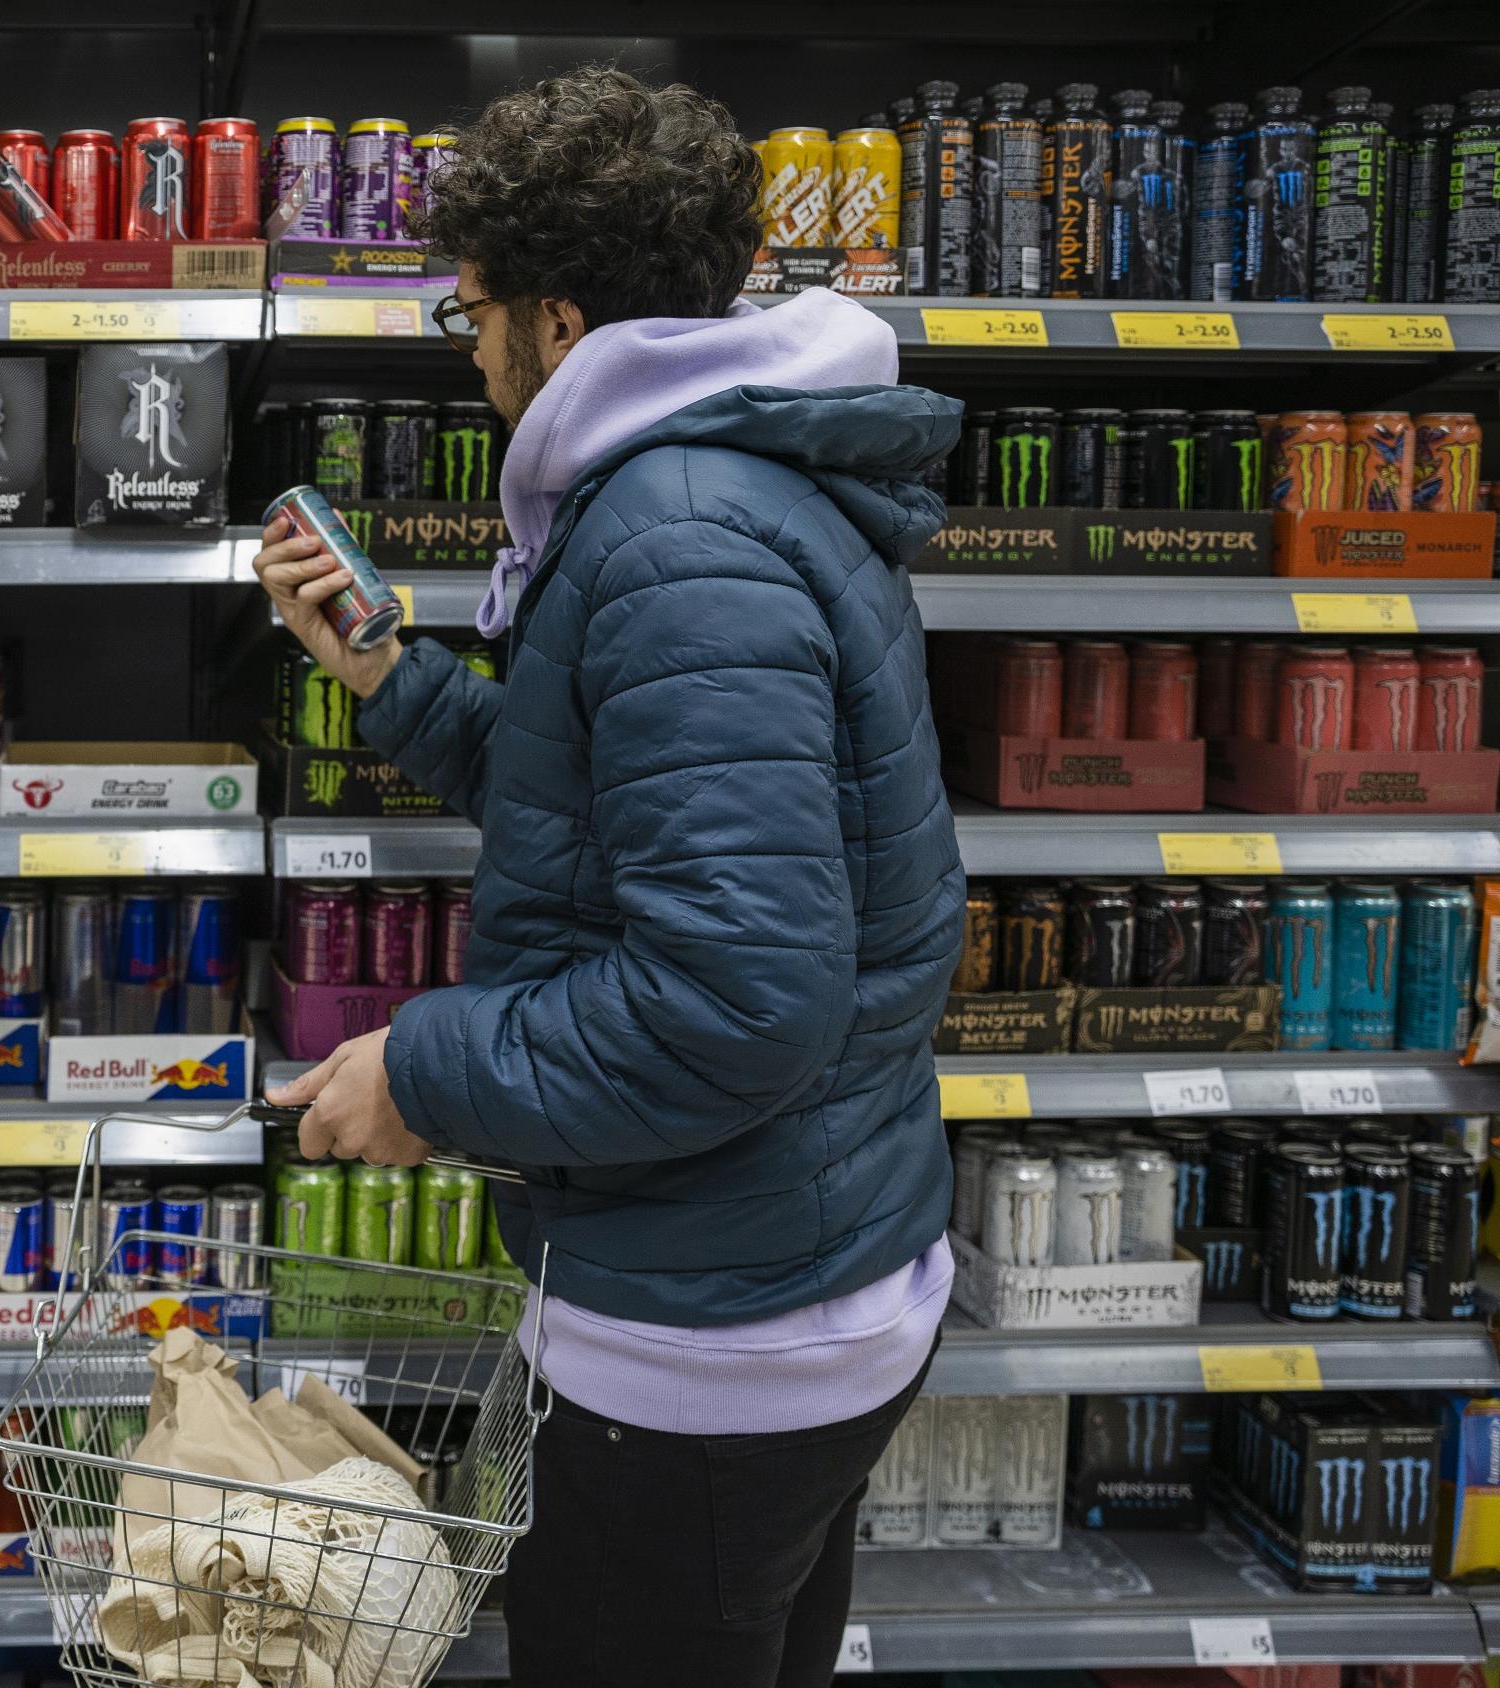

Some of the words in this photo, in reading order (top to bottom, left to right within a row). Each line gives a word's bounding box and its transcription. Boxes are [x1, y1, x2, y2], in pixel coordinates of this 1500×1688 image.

[1059, 142, 1083, 280] MONSTER
[102, 262, 151, 272] CHERRY
[829, 273, 903, 292] ALERT
[93, 313, 128, 327] £1.50
[1002, 322, 1039, 335] £2.50
[1194, 324, 1230, 337] £2.50
[1407, 327, 1444, 340] £2.50
[106, 467, 201, 511] Relentless
[132, 501, 162, 511] ENERGY
[165, 500, 192, 510] DRINK
[1122, 527, 1259, 551] MONSTER
[1339, 529, 1407, 546] JUICED
[948, 551, 1036, 562] ENERGY
[1416, 543, 1482, 553] MONARCH
[1146, 552, 1233, 563] ENERGY
[320, 852, 367, 871] £1.70
[942, 1012, 1047, 1030] MONSTER
[1128, 1003, 1241, 1026] MONSTER
[959, 1031, 1028, 1045] MULE
[67, 1060, 105, 1078] Red
[109, 1059, 146, 1077] Bull
[1180, 1086, 1224, 1105] £1.70
[1330, 1087, 1374, 1105] £1.70
[1058, 1285, 1179, 1305] MONSTER
[1097, 1481, 1193, 1499] MONSTER
